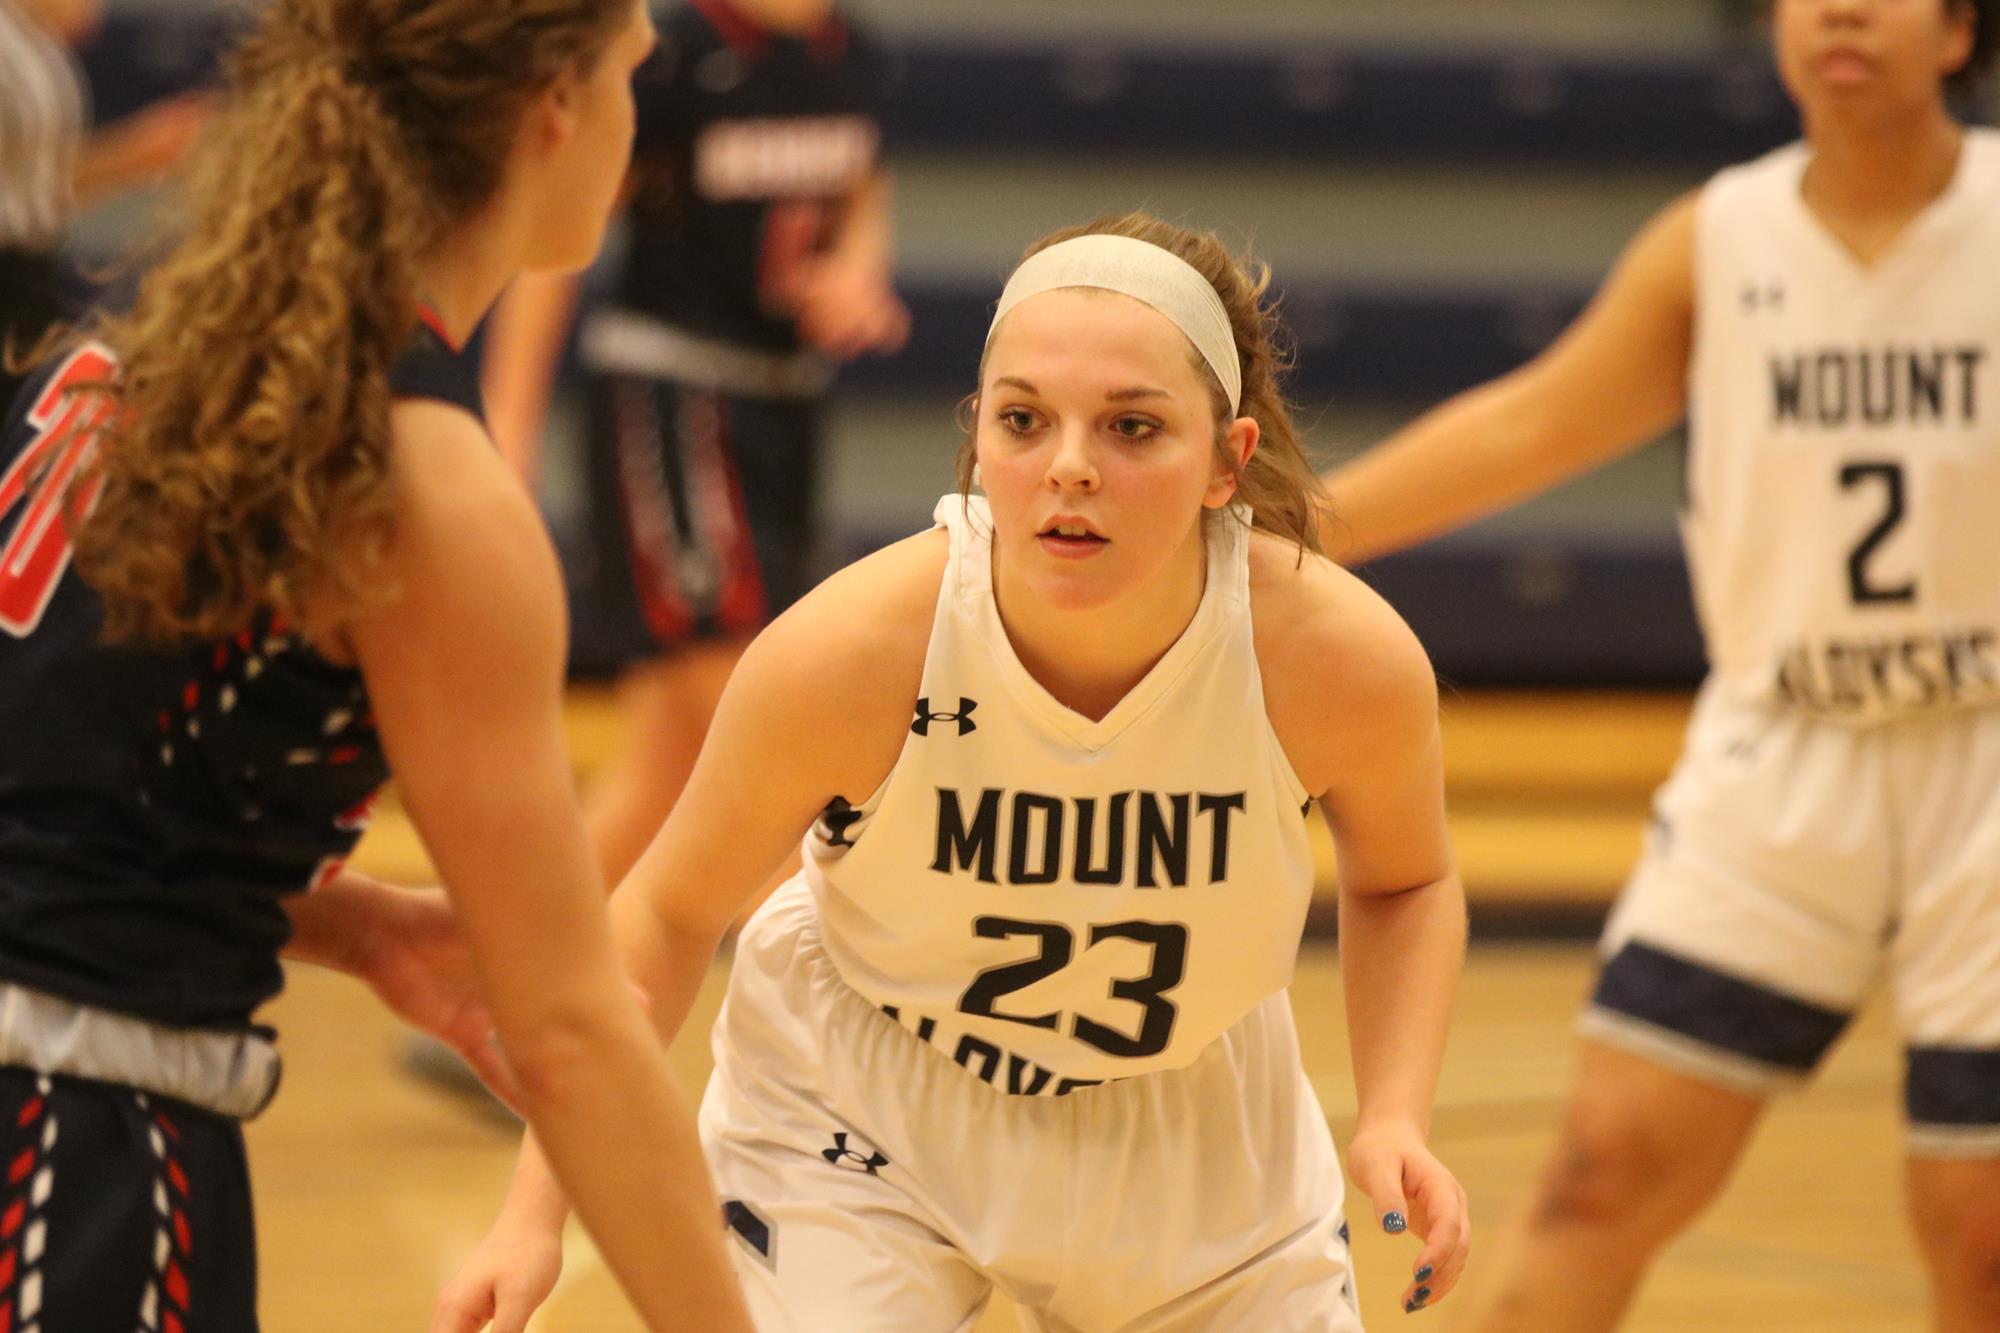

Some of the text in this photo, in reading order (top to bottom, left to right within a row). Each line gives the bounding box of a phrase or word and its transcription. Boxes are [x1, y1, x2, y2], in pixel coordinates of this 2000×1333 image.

[1768, 346, 1985, 425] MOUNT
[1838, 460, 1918, 605] 2
[929, 785, 1248, 889] MOUNT
[954, 914, 1191, 1058] 23
